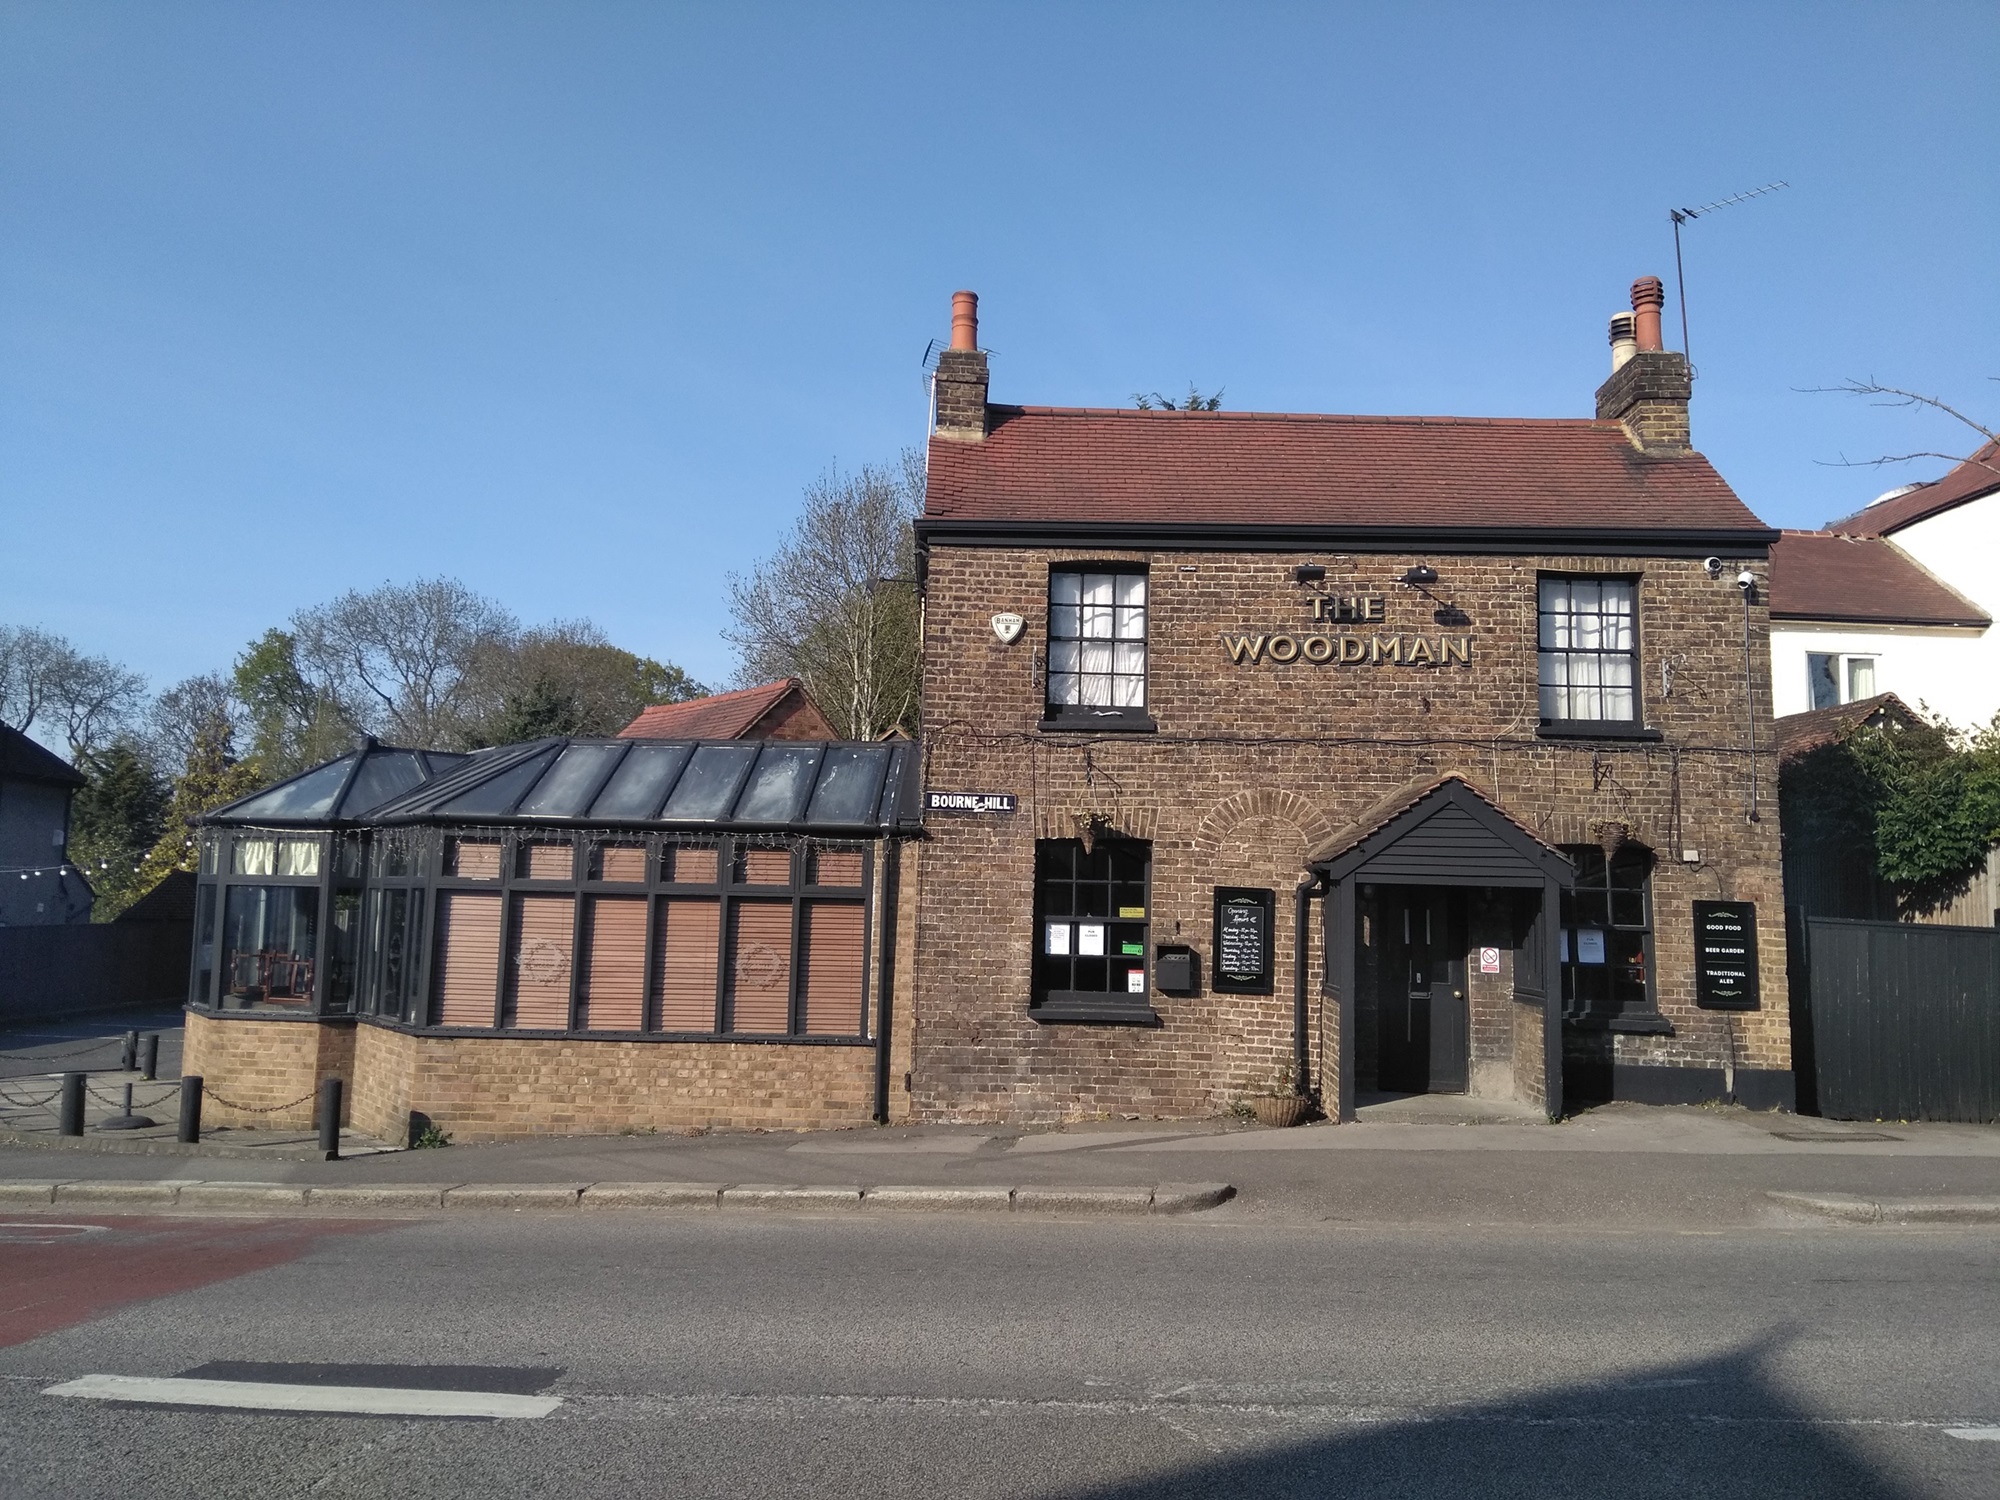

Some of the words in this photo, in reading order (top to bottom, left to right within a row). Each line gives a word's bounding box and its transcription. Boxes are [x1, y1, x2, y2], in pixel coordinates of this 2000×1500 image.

[1306, 596, 1385, 623] THE
[1224, 634, 1472, 667] WOODMAN
[931, 794, 979, 809] BOURNE
